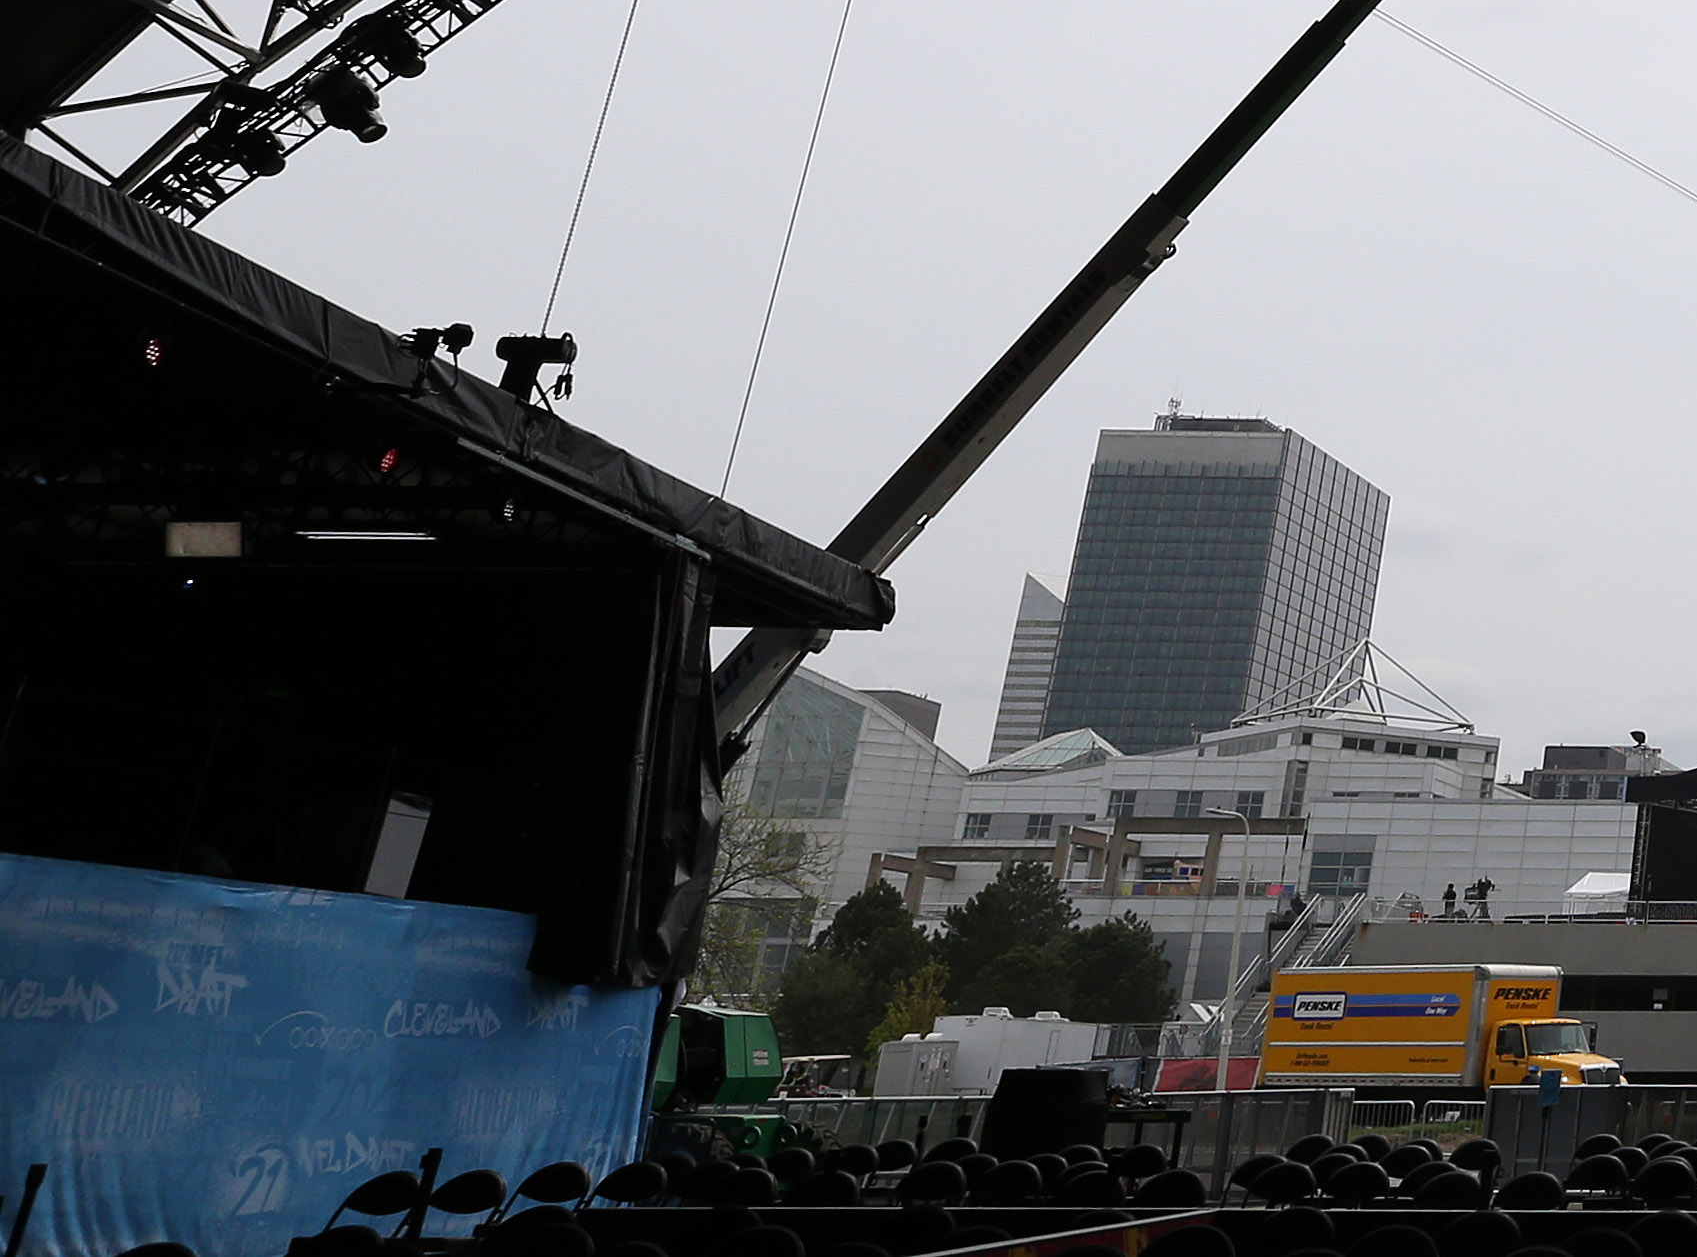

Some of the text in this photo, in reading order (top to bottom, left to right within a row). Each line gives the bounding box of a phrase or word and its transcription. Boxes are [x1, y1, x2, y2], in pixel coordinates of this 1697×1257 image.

[941, 268, 1106, 450] SUNBELT RENTALS
[1297, 1000, 1343, 1012] PENSKE
[1494, 988, 1553, 1001] PENSKE
[384, 1000, 502, 1039] CLEVELAND
